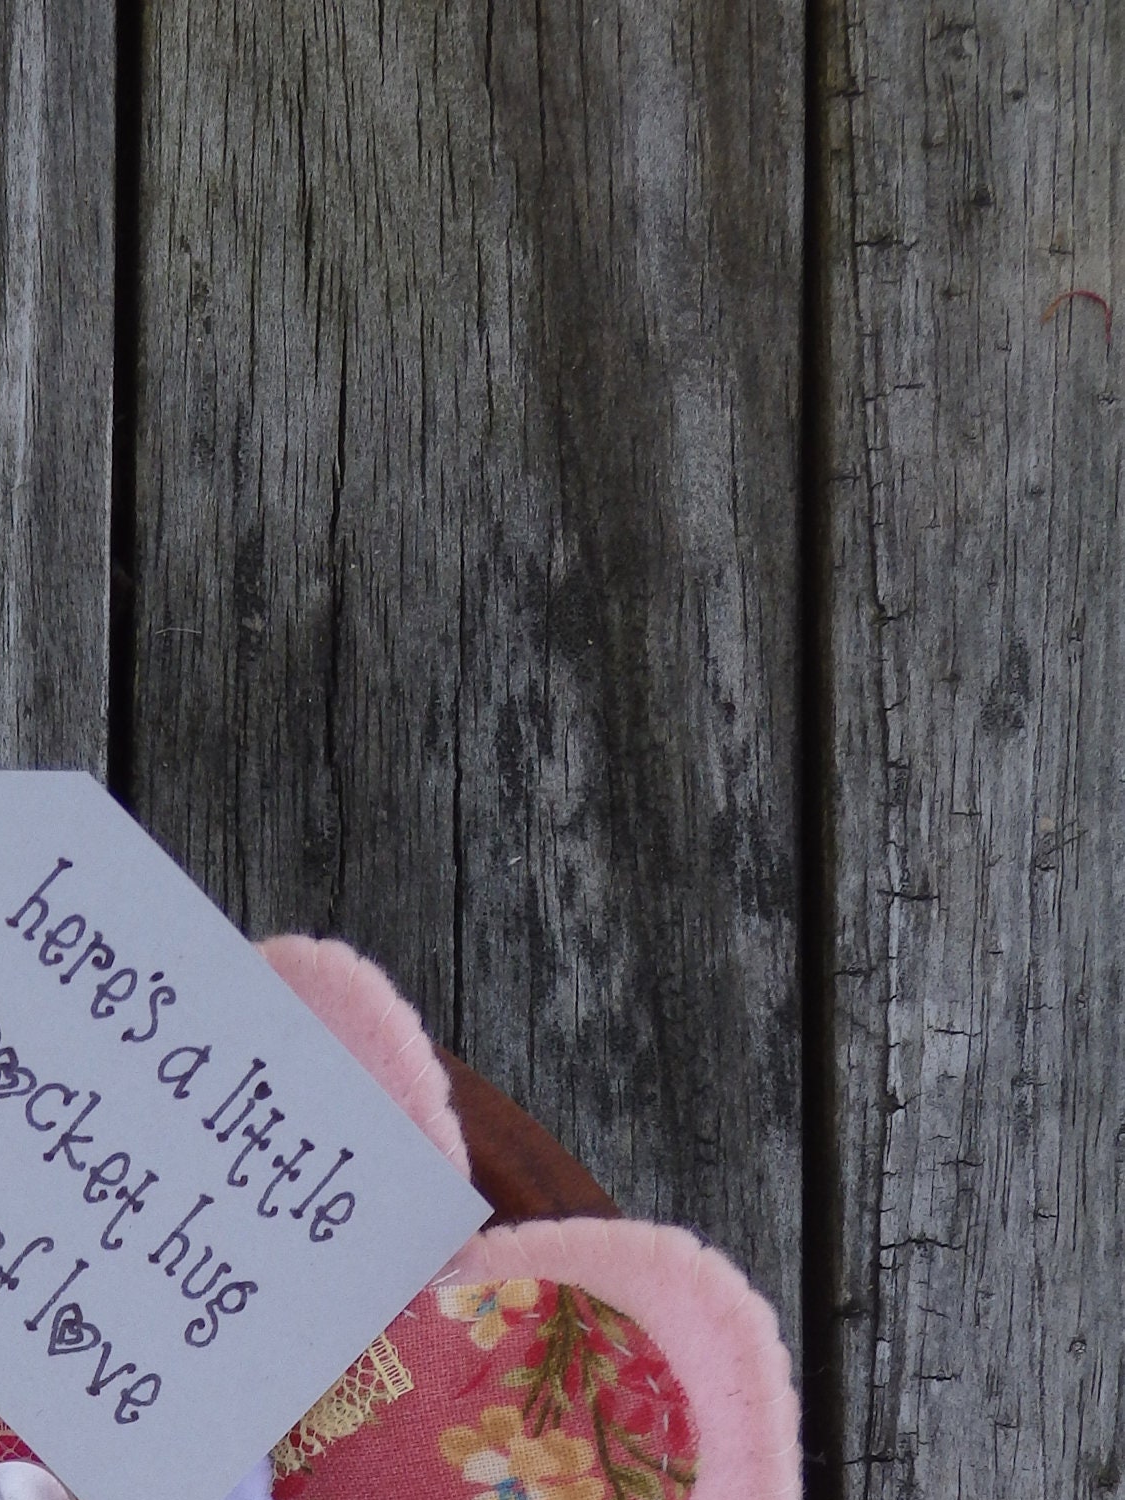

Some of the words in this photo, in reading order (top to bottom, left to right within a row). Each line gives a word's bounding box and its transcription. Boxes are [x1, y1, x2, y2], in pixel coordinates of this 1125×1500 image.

[5, 857, 176, 1042] here's
[158, 1045, 211, 1099] a
[201, 1058, 355, 1242] little
[148, 1194, 258, 1348] hug
